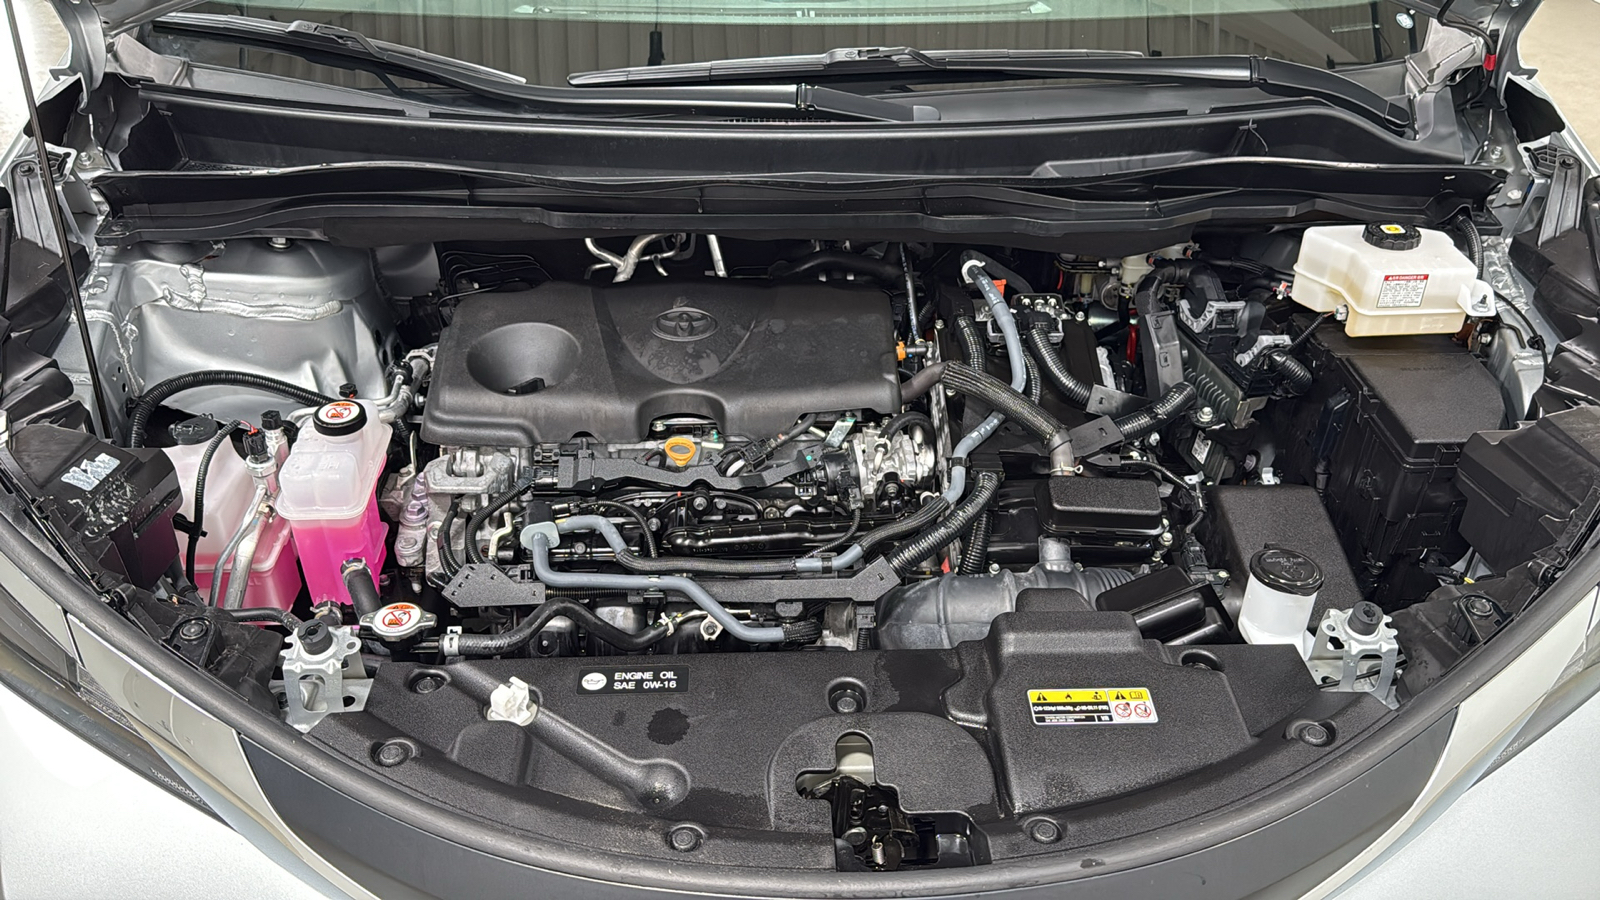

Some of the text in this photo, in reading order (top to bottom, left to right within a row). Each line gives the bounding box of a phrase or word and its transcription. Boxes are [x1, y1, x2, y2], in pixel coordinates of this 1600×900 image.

[614, 671, 678, 680] ENGINE OIL
[613, 680, 677, 690] SAE 0W-16
